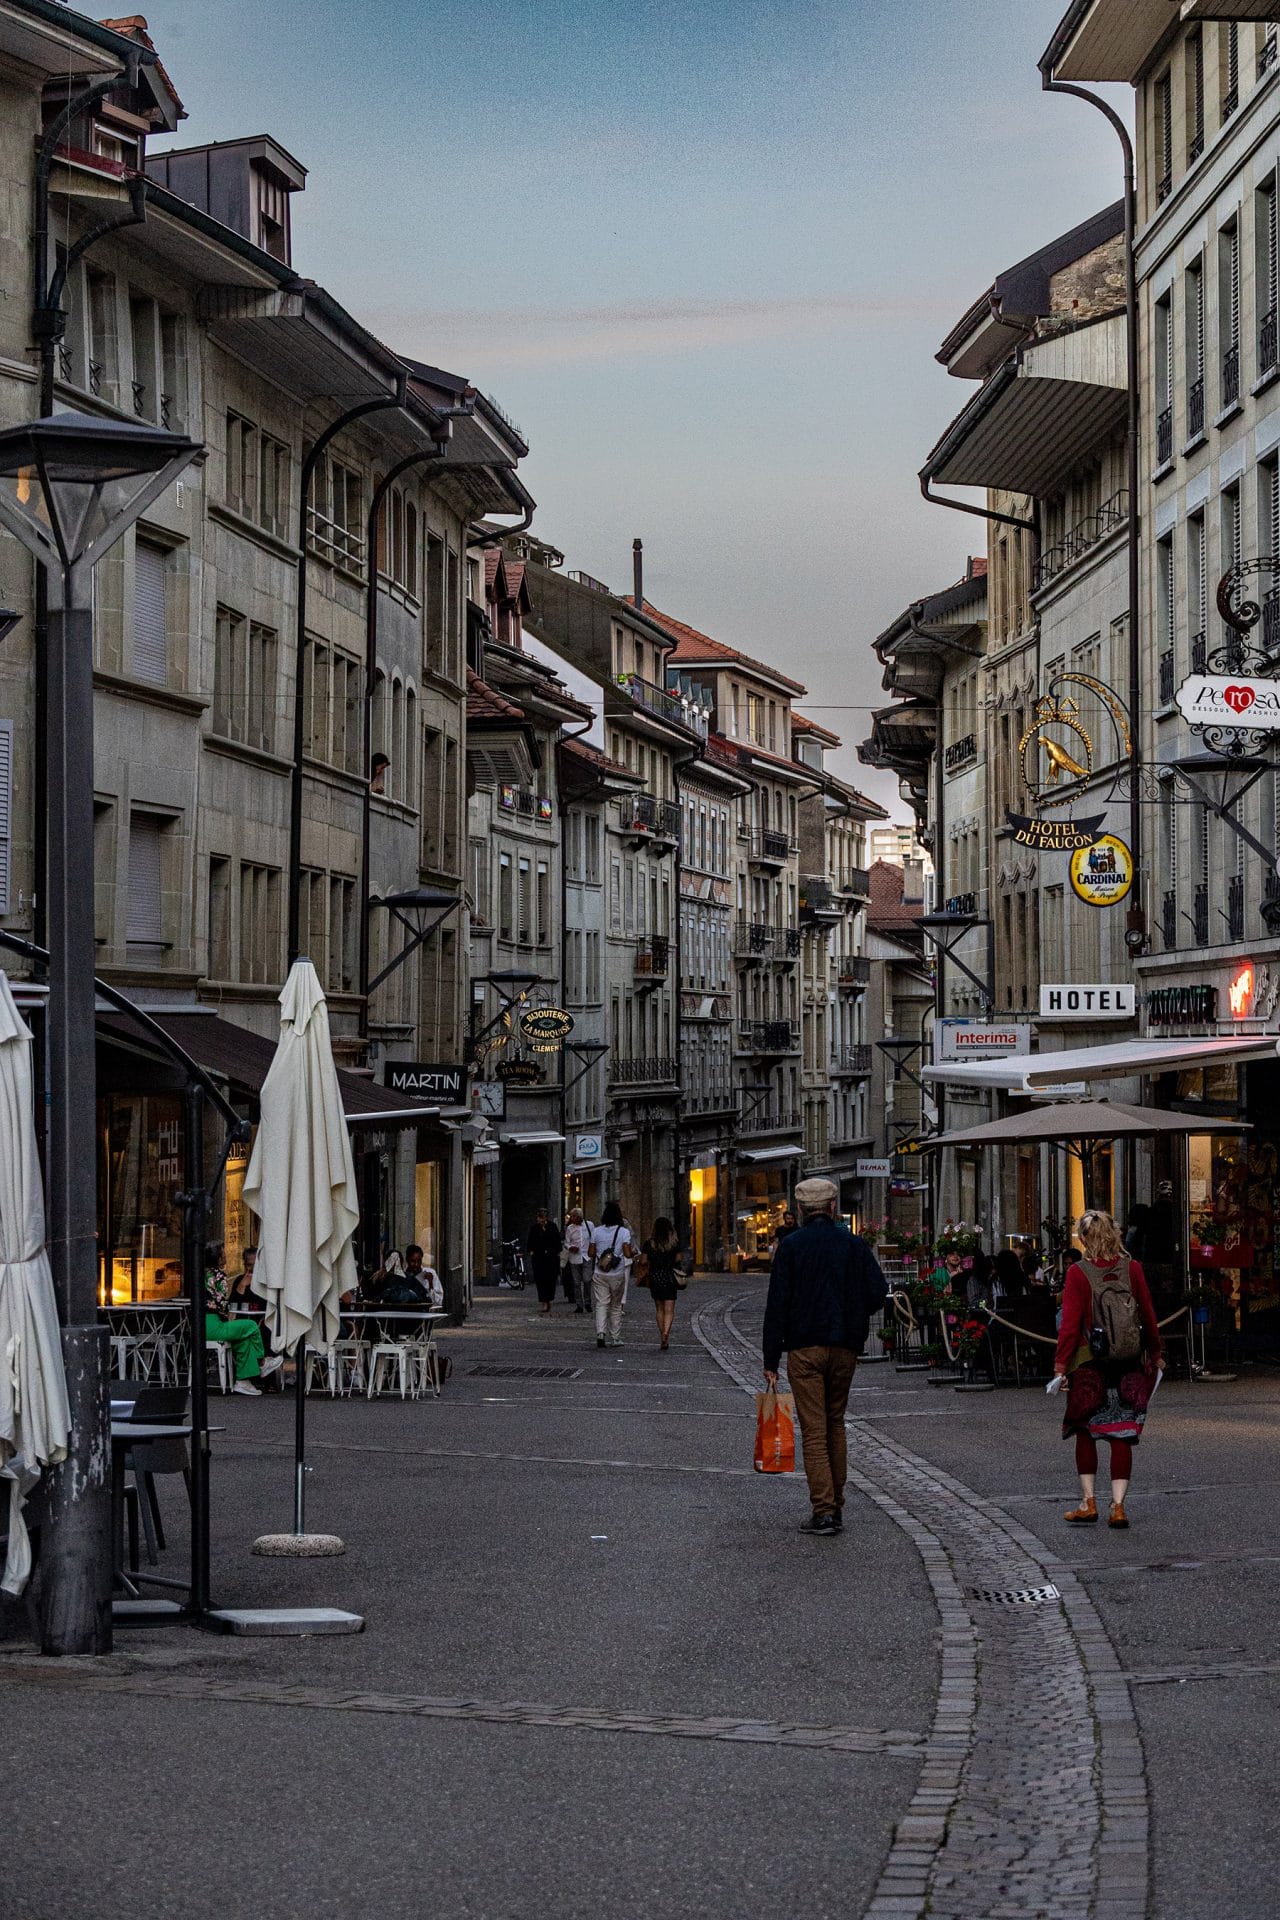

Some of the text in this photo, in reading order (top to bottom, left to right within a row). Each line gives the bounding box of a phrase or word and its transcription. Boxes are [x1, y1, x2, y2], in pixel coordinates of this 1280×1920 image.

[1195, 686, 1280, 709] Perosa
[1030, 820, 1079, 836] HÔTEL
[1015, 830, 1093, 849] DU FAUCON
[1077, 873, 1129, 885] CARDINAL
[1049, 990, 1127, 1010] HOTEL
[526, 1010, 570, 1023] BIJOUTERIE
[523, 1023, 572, 1038] LA MARQUISE
[956, 1032, 1017, 1044] Interima
[392, 1072, 460, 1090] MARTINI
